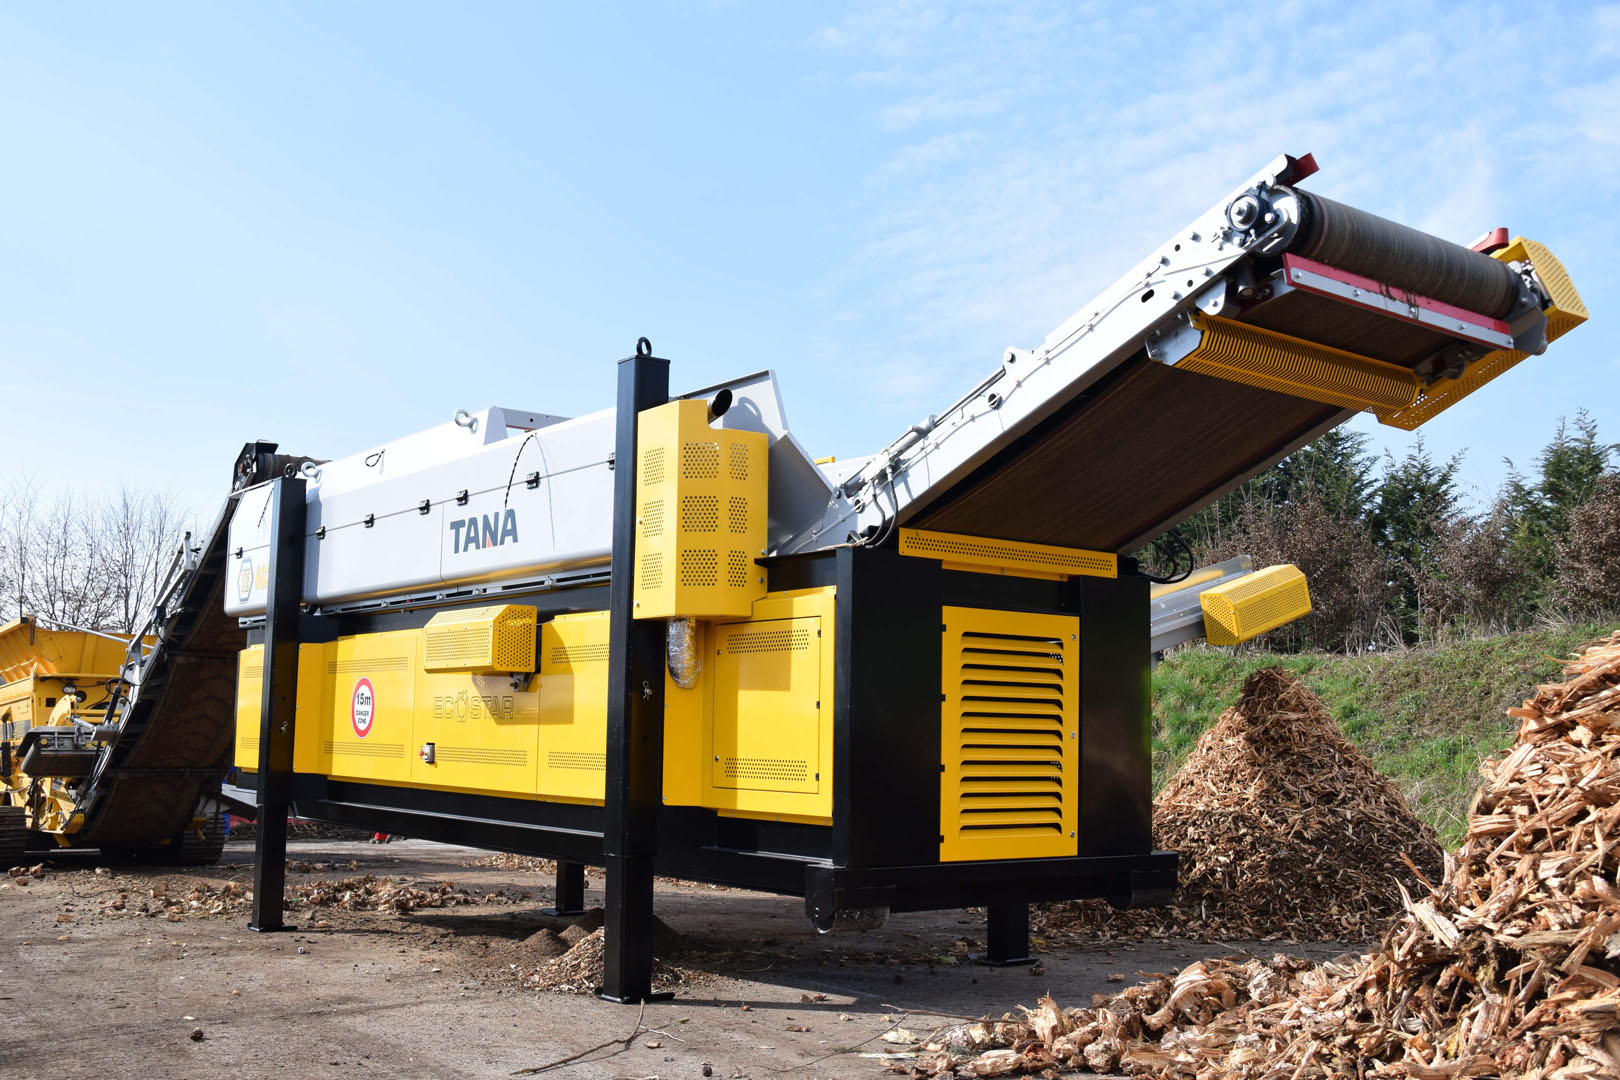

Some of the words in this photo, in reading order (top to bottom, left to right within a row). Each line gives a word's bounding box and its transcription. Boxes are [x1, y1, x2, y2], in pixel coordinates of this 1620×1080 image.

[450, 509, 518, 554] TANA
[356, 692, 371, 706] 15m
[356, 709, 369, 717] DANGER
[357, 717, 367, 725] ZONE
